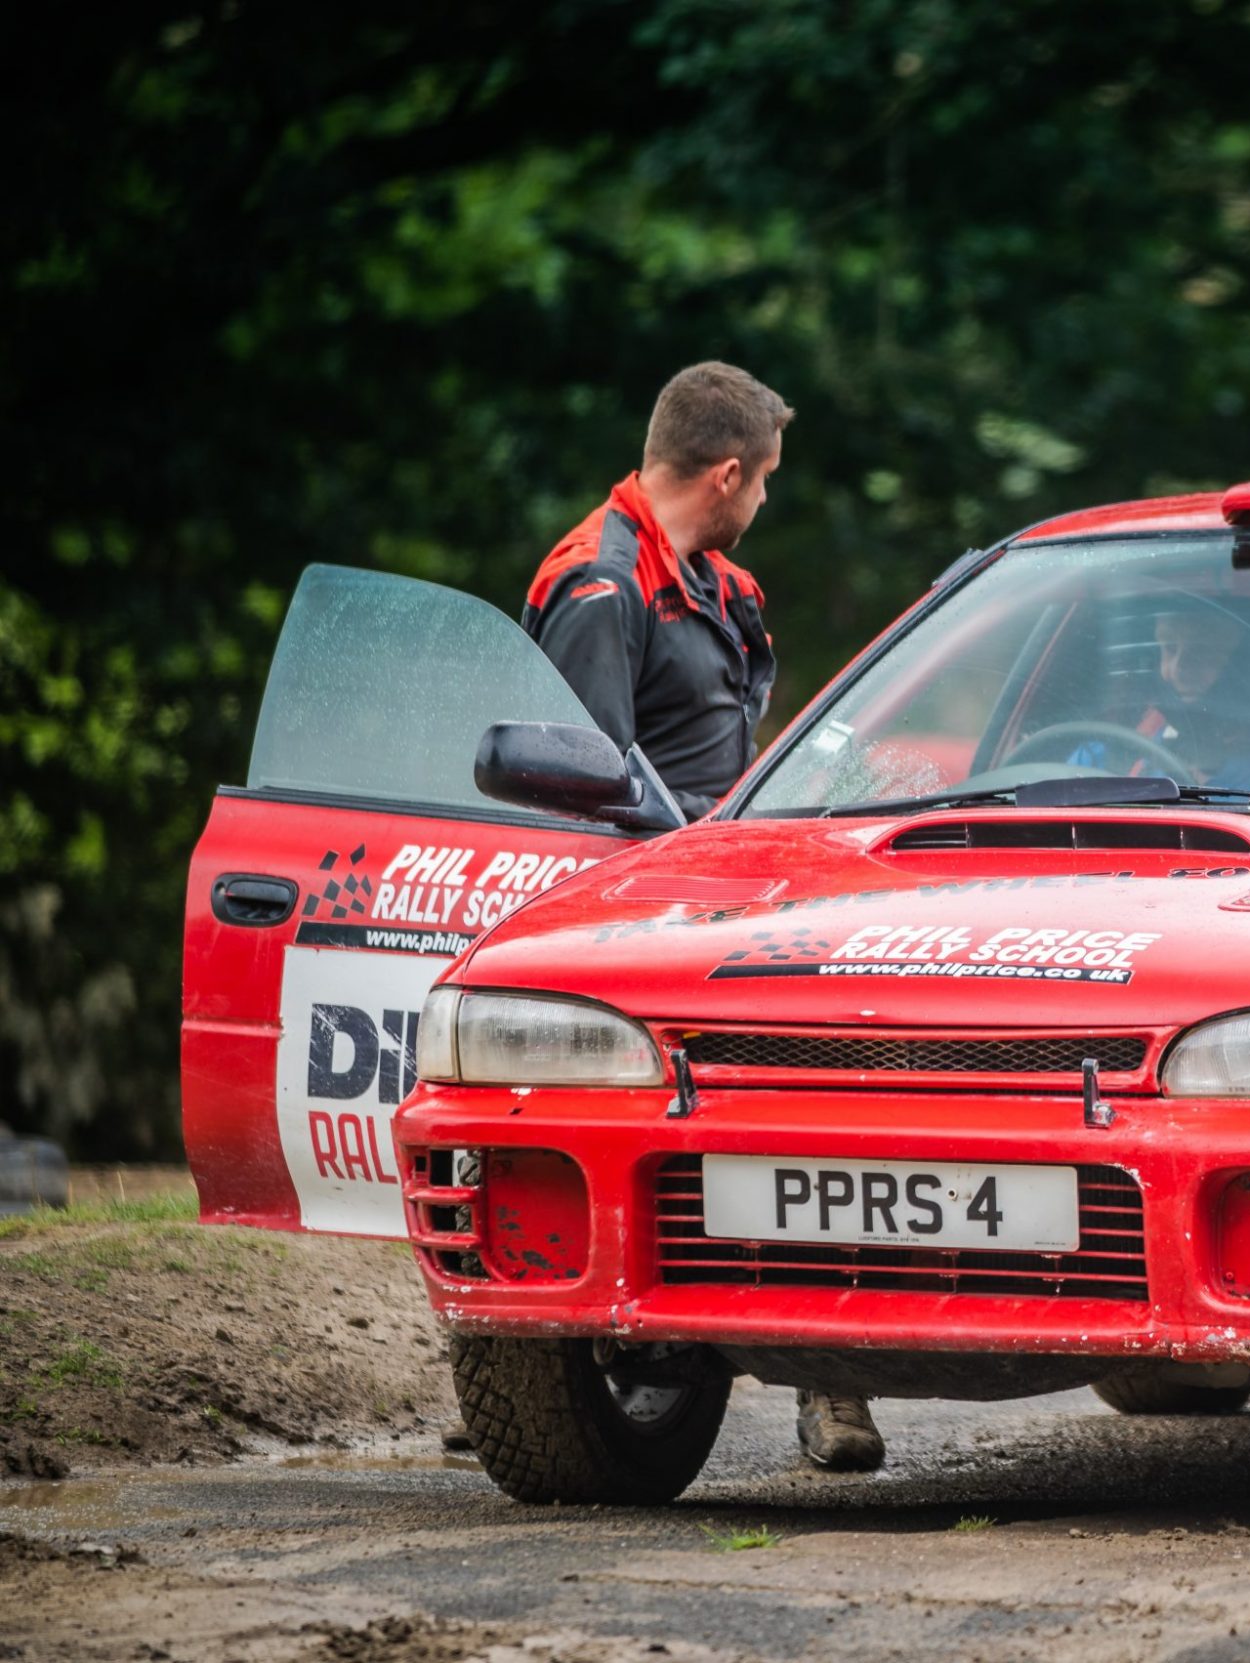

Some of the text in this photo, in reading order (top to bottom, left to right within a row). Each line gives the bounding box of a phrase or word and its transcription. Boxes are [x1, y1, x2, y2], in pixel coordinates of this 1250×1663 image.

[382, 845, 601, 891] PHIL PRIC
[917, 870, 1145, 898] WHEEL
[371, 883, 526, 929] RALLY SCH
[366, 929, 476, 957] www.philp
[829, 942, 1134, 967] RALLY SCHOOL
[846, 925, 1163, 951] PHIL PRICE
[308, 1110, 399, 1185] RAL
[774, 1168, 1003, 1237] PPRS 4
